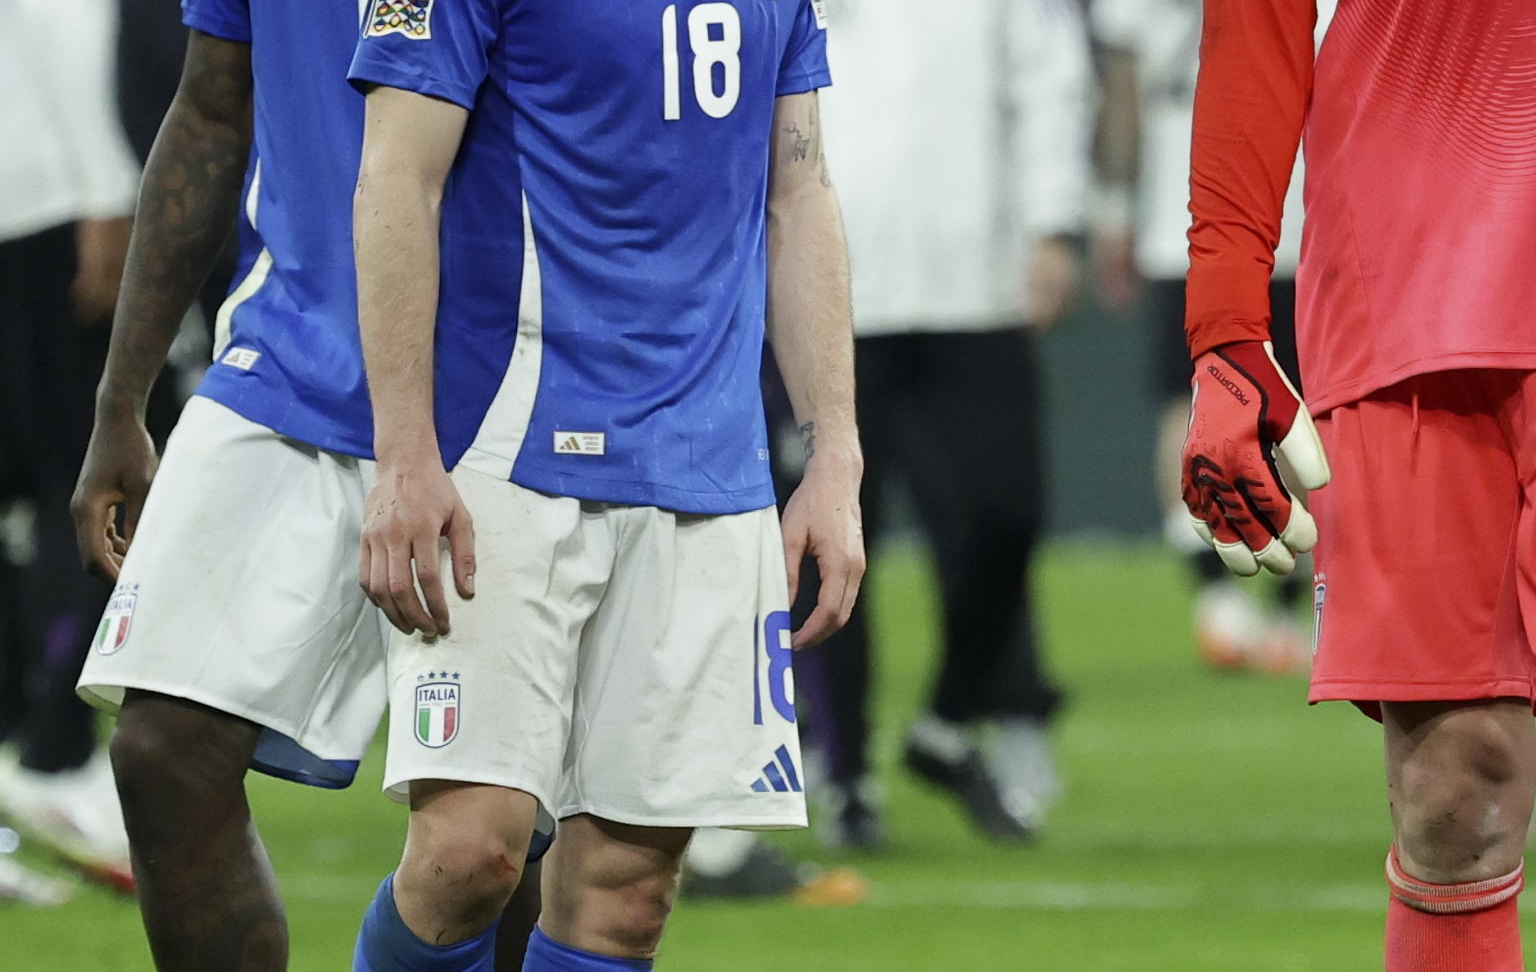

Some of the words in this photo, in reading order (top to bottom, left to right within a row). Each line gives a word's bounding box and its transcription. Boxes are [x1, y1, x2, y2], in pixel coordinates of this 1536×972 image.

[662, 1, 741, 121] 18
[1207, 363, 1250, 406] PREDATOR
[418, 688, 457, 702] ITALIA
[753, 611, 796, 726] 18
